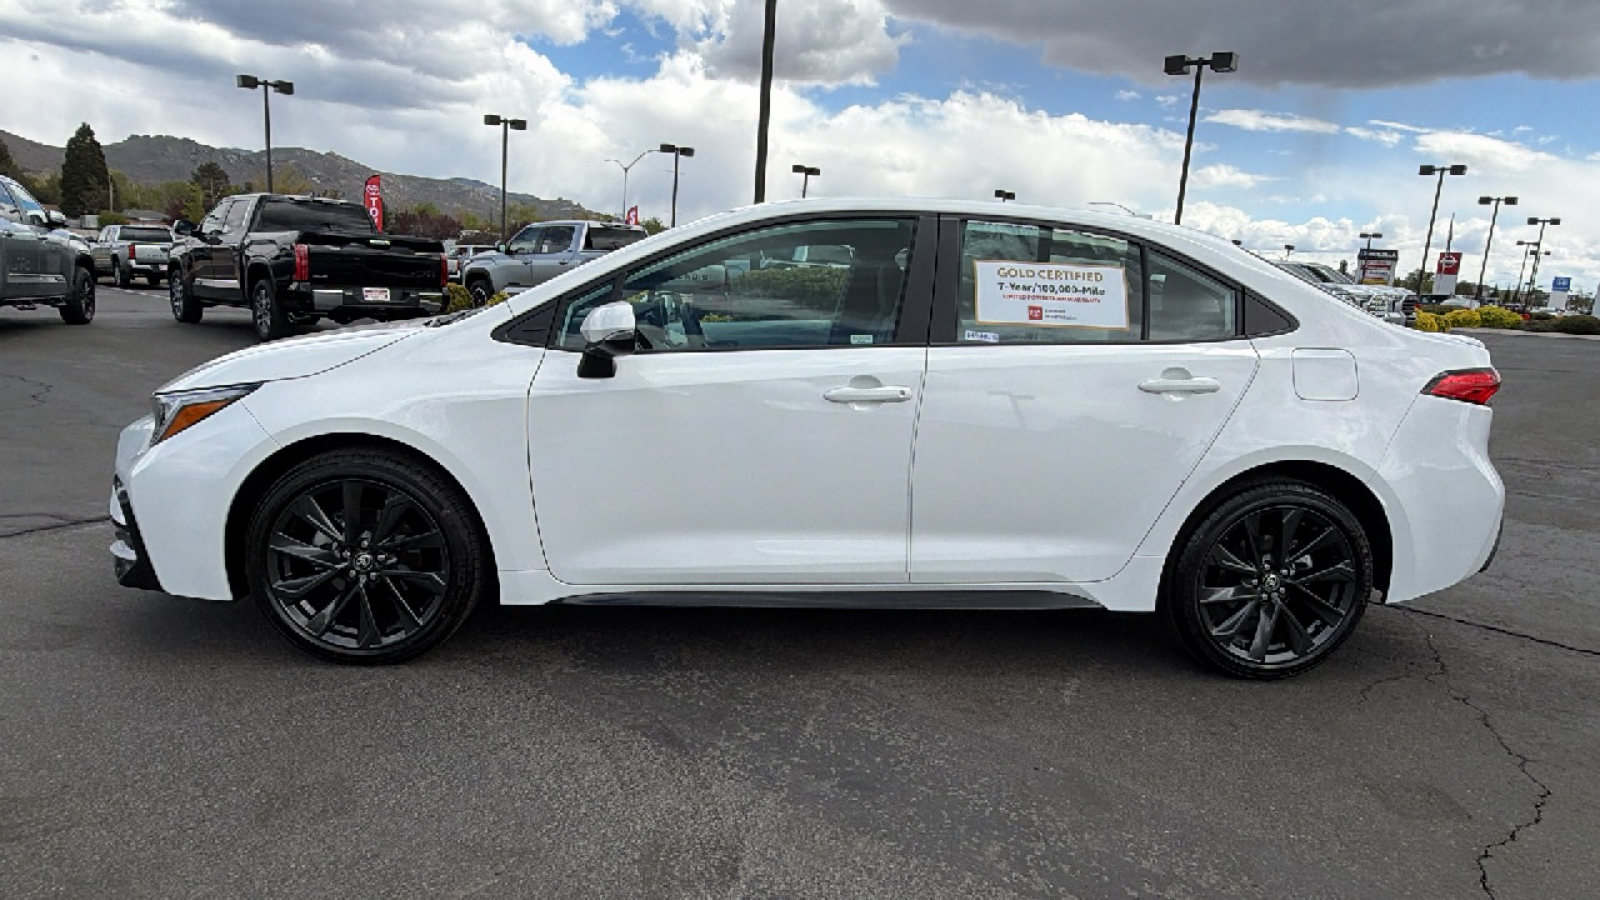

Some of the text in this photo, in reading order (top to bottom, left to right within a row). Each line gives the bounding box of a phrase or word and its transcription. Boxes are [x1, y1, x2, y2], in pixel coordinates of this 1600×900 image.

[997, 267, 1103, 282] GOLD CERTIFIED
[998, 282, 1105, 295] 7-Year/100,000-Mile
